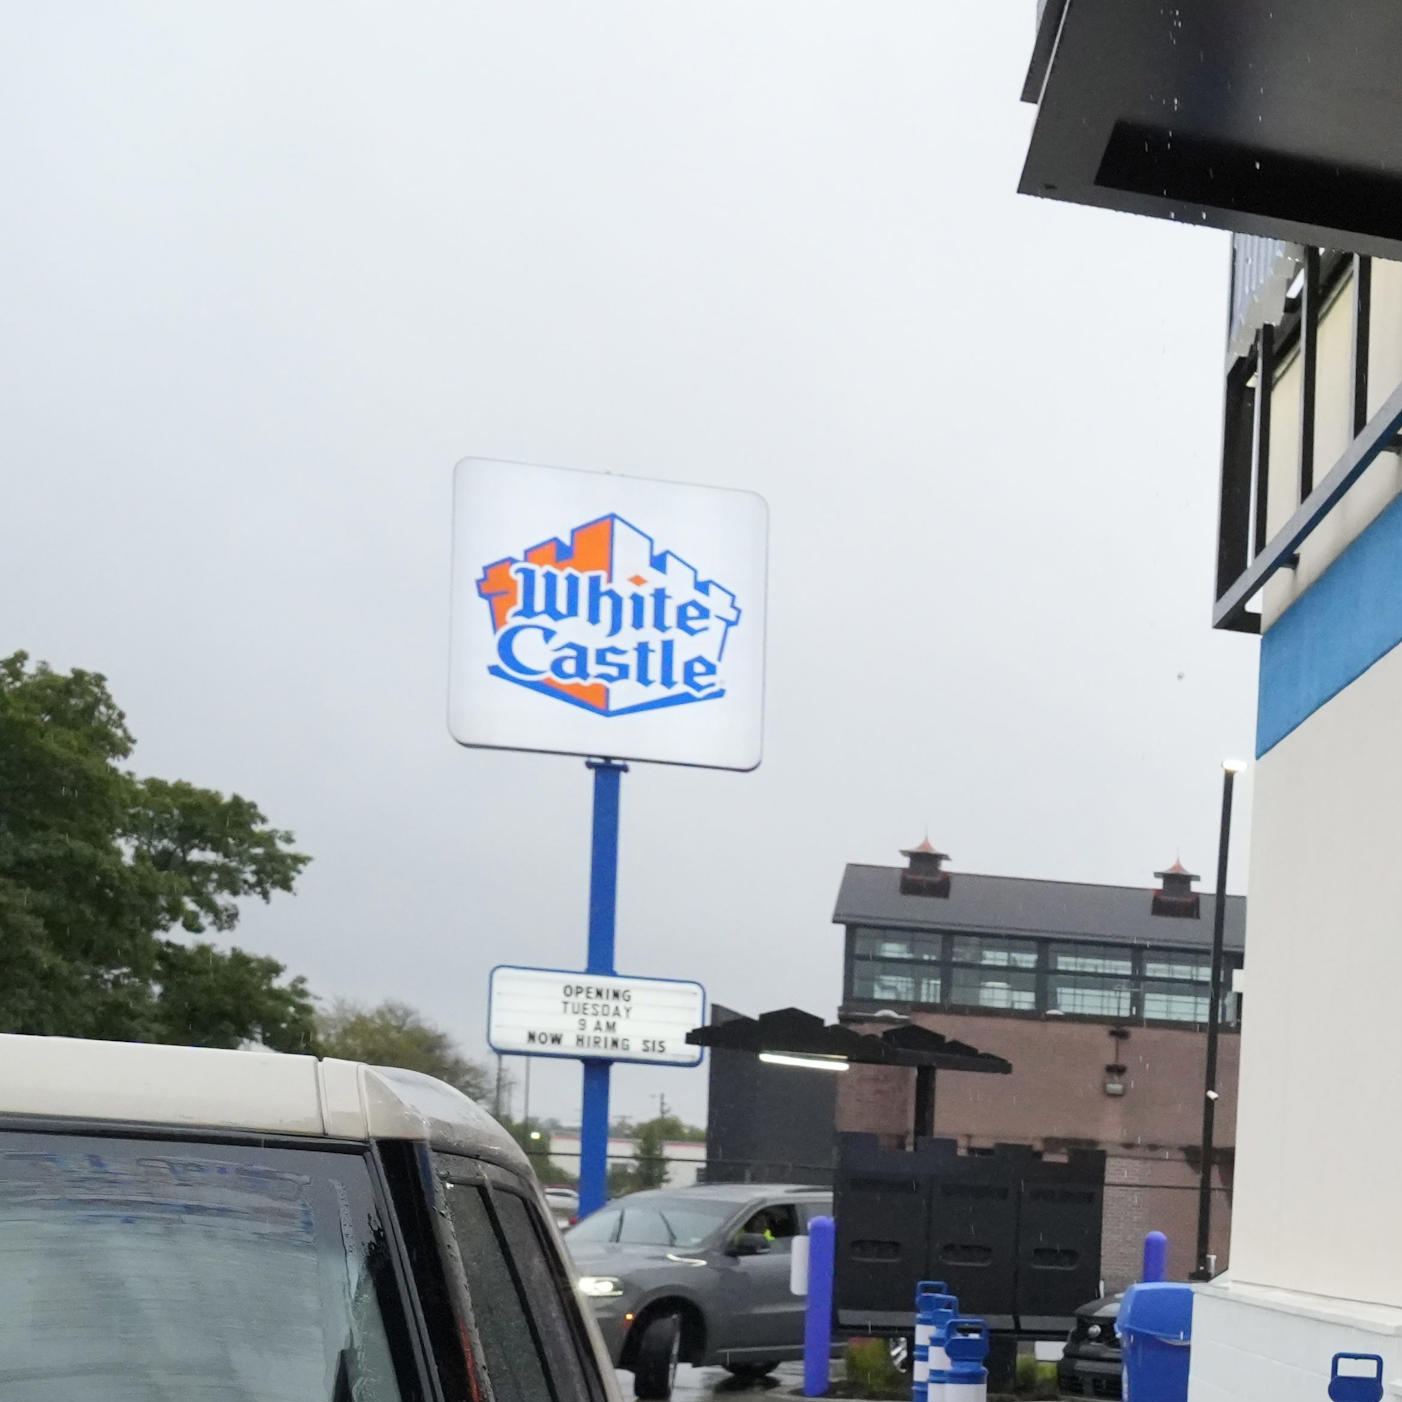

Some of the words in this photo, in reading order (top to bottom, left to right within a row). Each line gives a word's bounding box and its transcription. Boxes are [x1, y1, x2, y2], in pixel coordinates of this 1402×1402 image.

[511, 567, 711, 637] White
[497, 624, 718, 692] Castle
[563, 984, 632, 1002] OPENING
[562, 1001, 632, 1018] TUESDAY
[578, 1018, 587, 1031] 9
[593, 1020, 617, 1033] AM
[526, 1031, 563, 1046] NOW
[576, 1034, 631, 1051] HIRING
